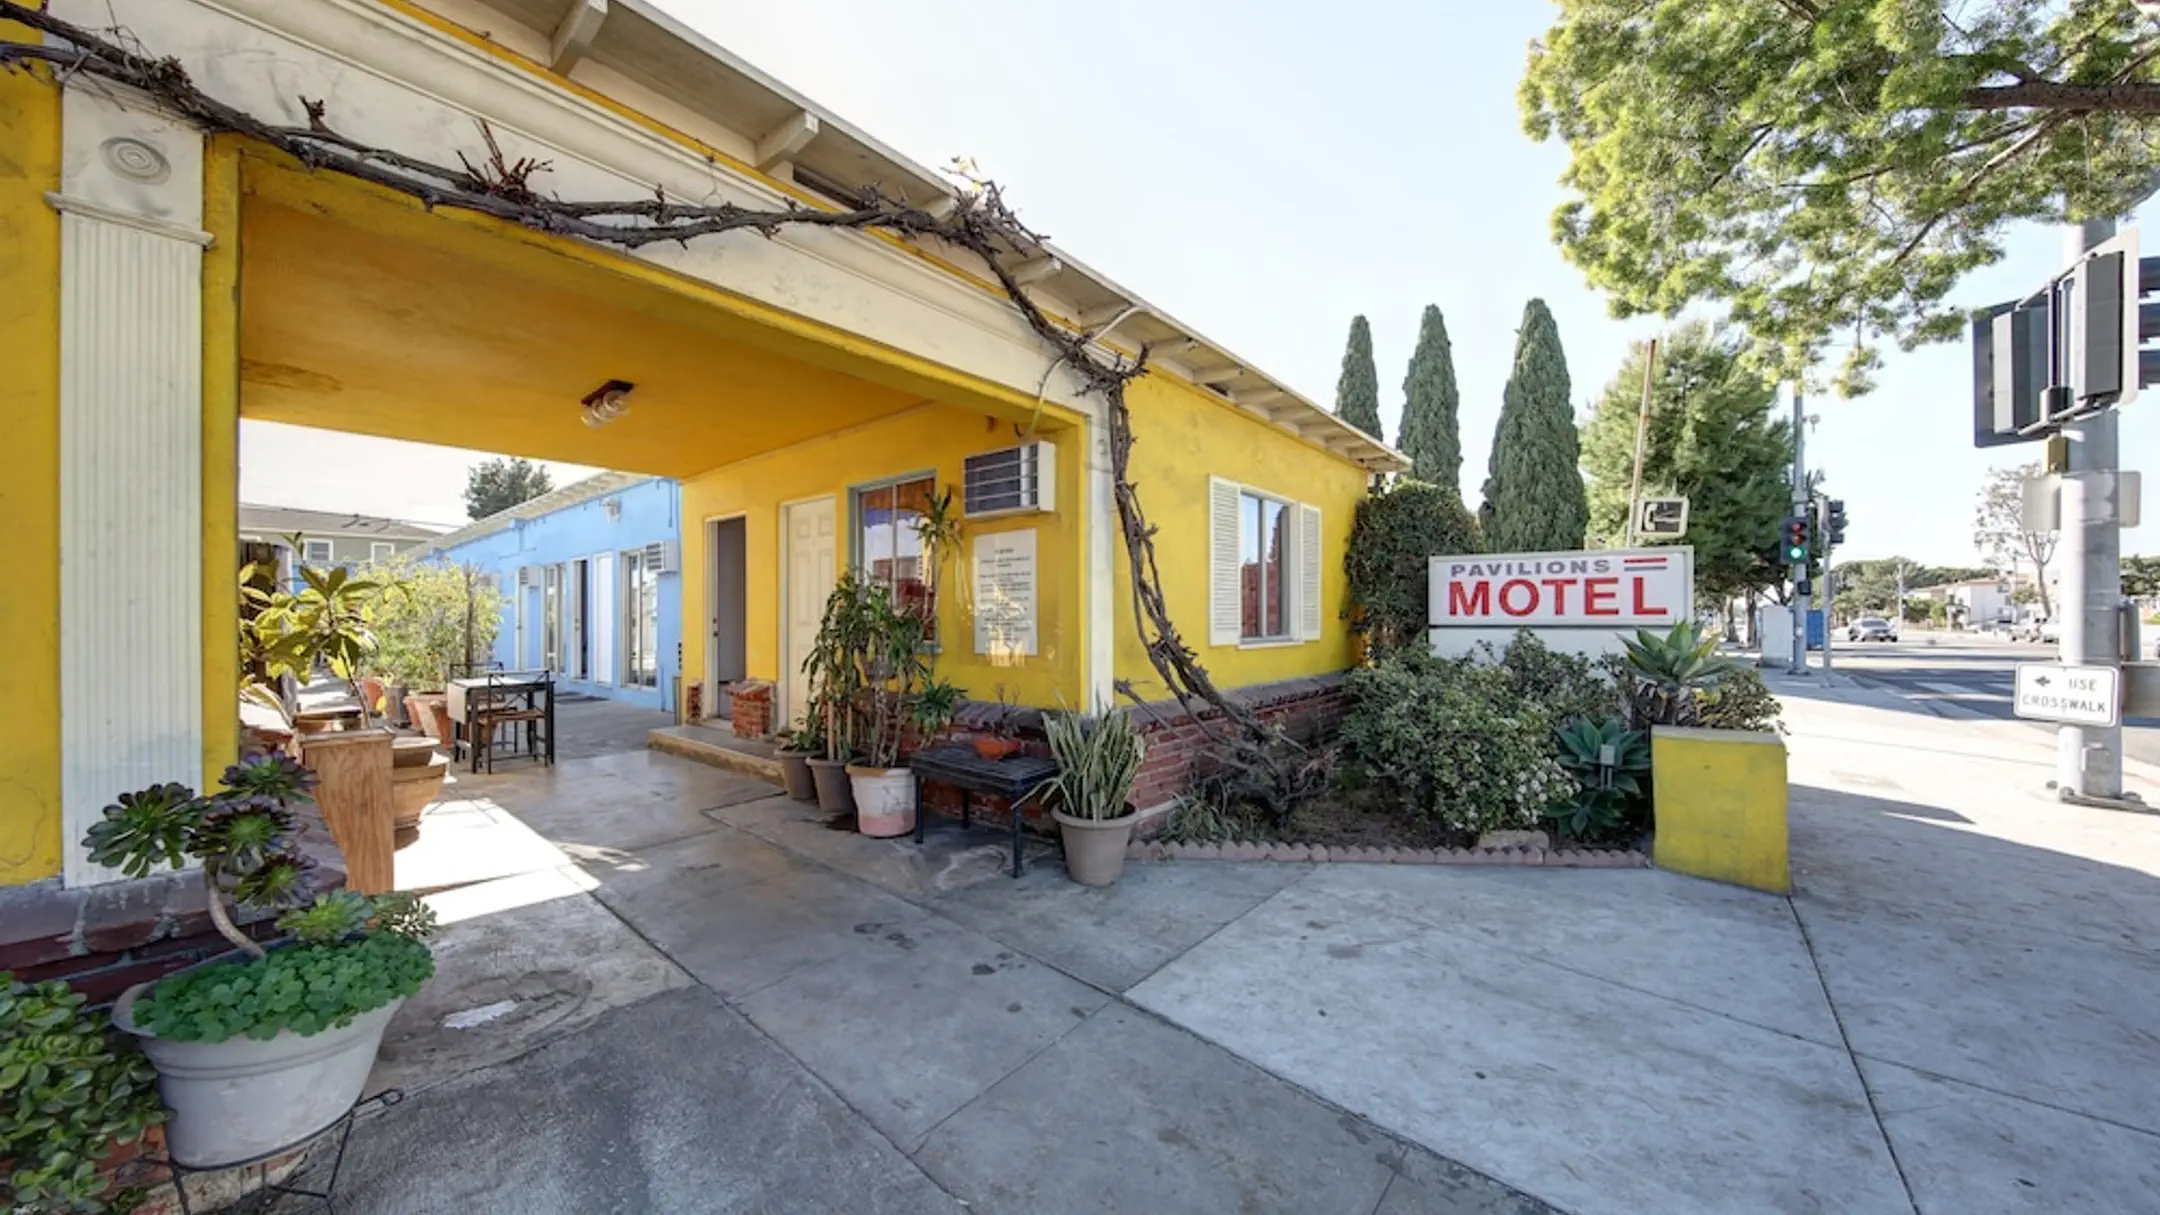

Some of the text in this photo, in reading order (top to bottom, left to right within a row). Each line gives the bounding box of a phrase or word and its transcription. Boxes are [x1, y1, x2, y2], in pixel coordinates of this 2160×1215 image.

[1451, 559, 1611, 578] PAVILIONS
[1449, 577, 1668, 616] MOTEL
[2068, 678, 2098, 692] USE
[2022, 694, 2106, 713] CROSSWALK
